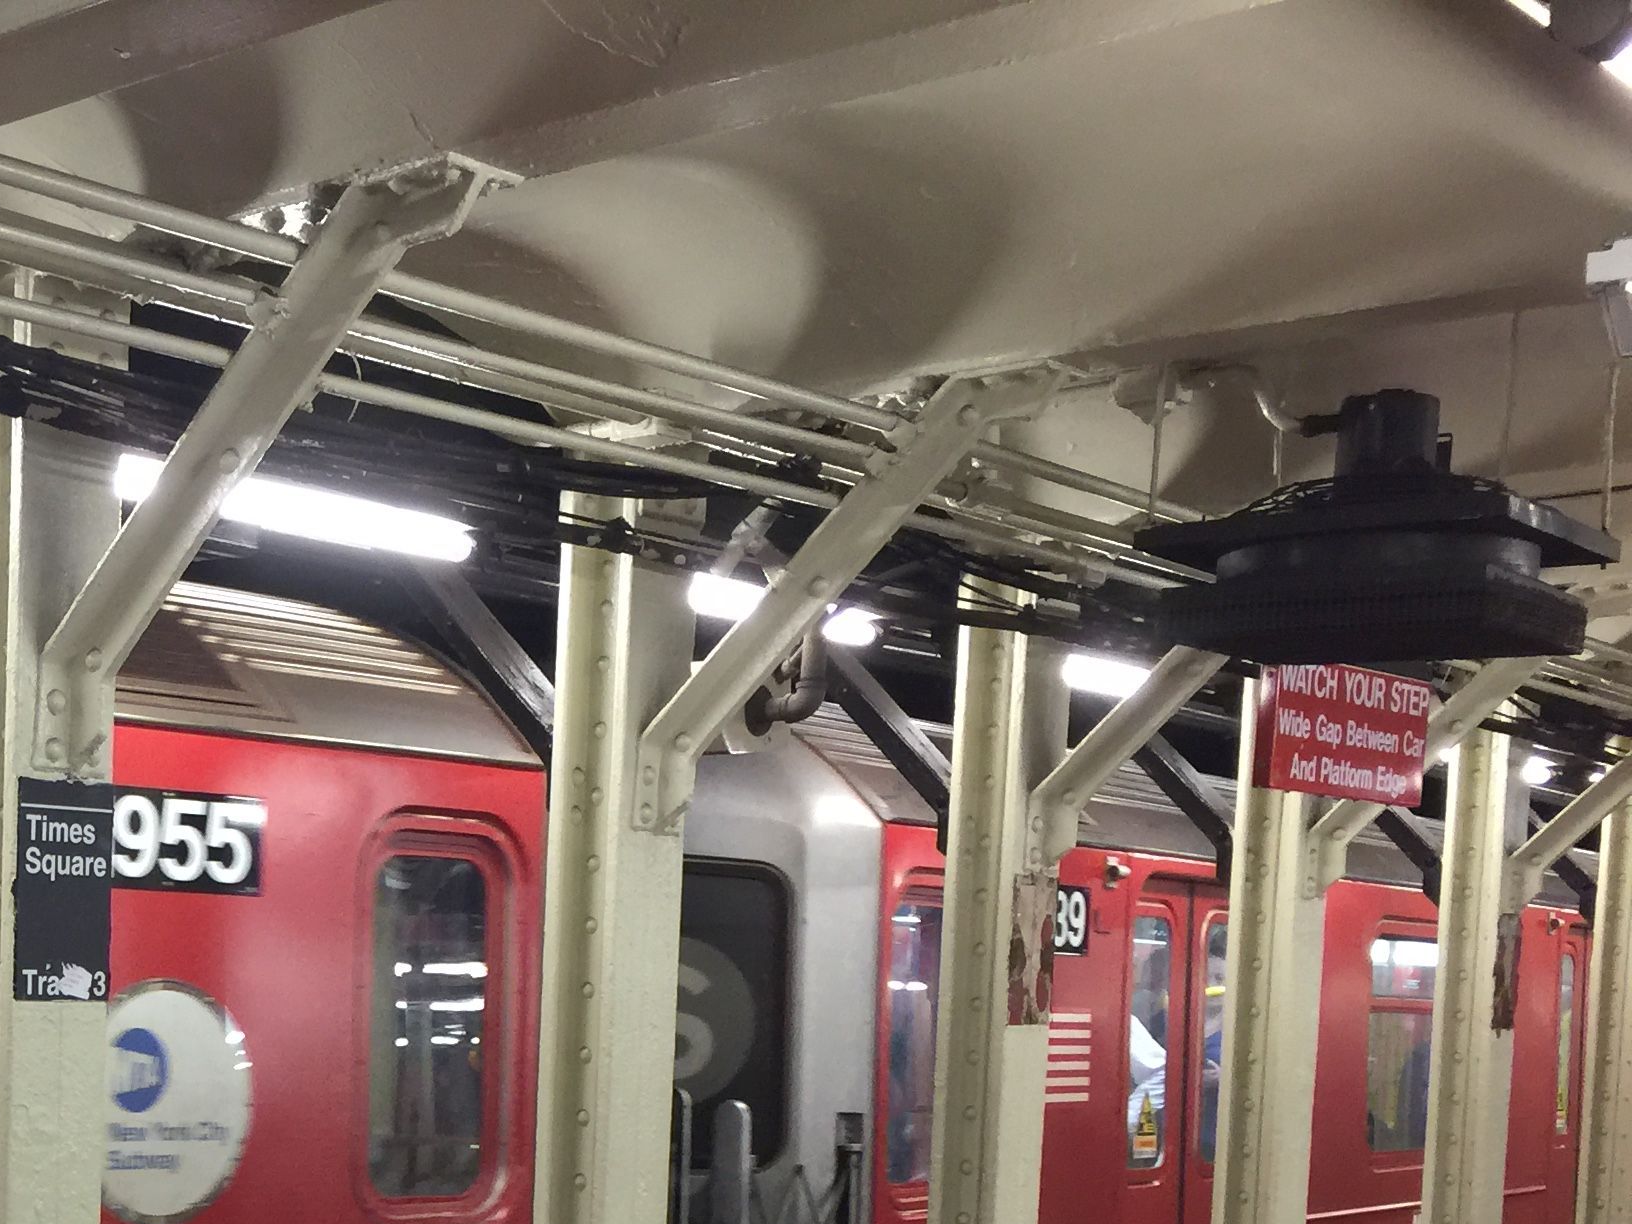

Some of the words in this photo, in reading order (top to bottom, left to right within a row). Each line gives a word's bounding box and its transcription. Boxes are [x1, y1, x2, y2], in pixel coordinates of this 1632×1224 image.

[1281, 664, 1339, 701] WATCH
[1344, 670, 1386, 711] YOUR
[1390, 680, 1431, 718] STEP
[1279, 707, 1311, 740] Wide
[1316, 714, 1343, 750] Gap
[1346, 720, 1399, 754] Between
[1403, 730, 1425, 758] Car
[1289, 752, 1318, 783] And
[1320, 756, 1373, 790] Platform
[1376, 766, 1407, 799] Edge
[25, 813, 97, 845] Times
[112, 794, 267, 884] 955
[24, 846, 108, 882] Square
[21, 968, 76, 996] Tra
[92, 970, 106, 997] 3
